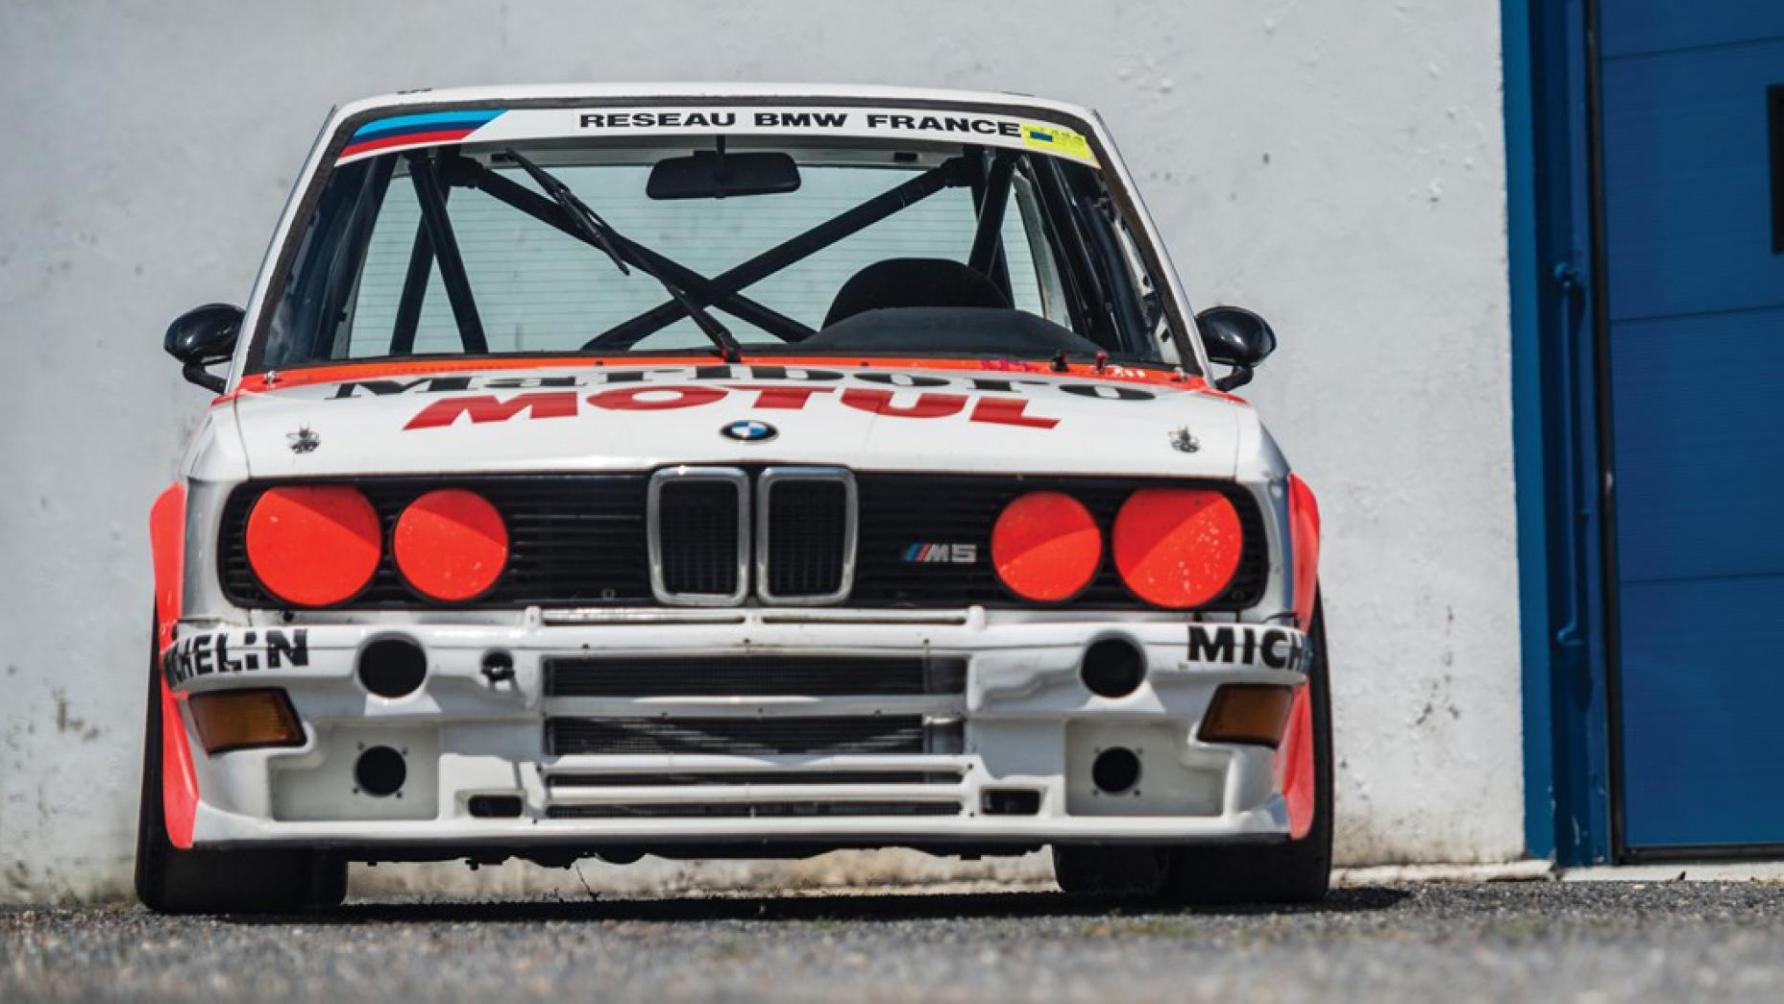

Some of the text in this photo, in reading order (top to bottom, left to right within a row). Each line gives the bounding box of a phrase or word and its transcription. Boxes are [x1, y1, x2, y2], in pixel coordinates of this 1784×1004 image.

[580, 113, 1022, 138] RESEAU BMW FRANCE
[403, 385, 1061, 430] MOTUL
